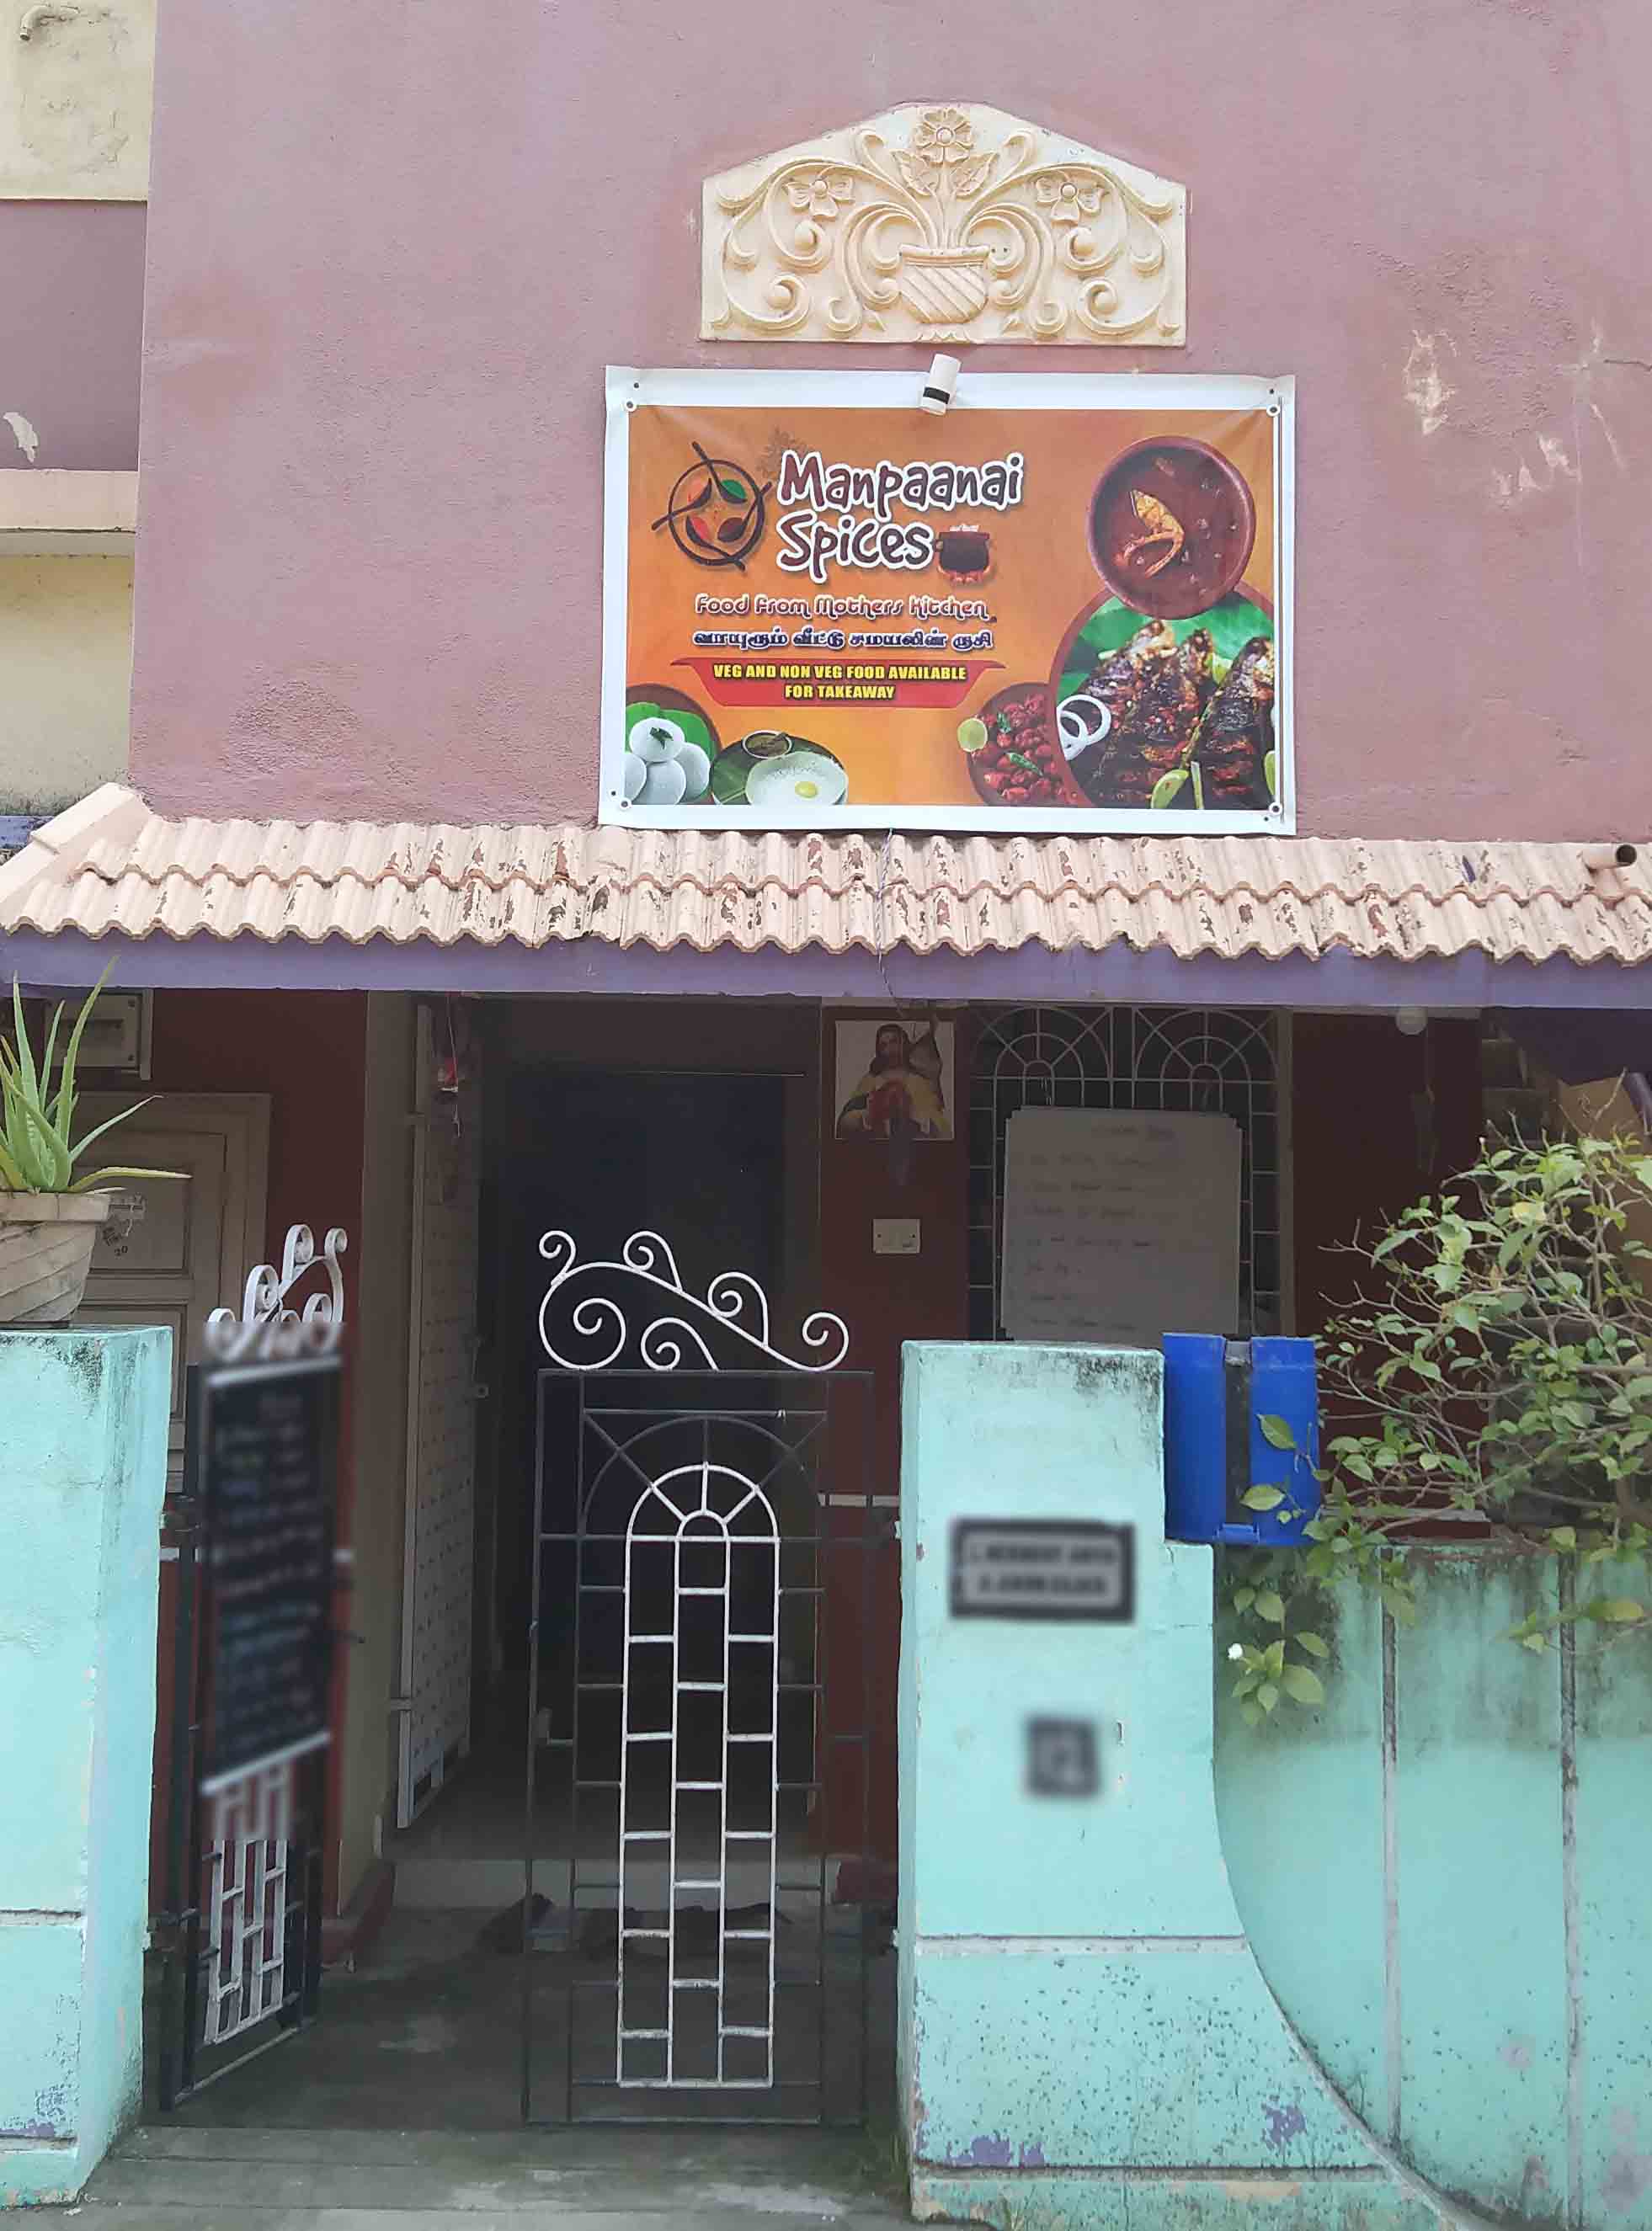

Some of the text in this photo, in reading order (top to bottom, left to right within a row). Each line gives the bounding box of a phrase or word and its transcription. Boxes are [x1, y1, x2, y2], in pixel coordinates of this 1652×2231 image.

[779, 452, 1022, 519] Manpaanai
[777, 510, 934, 581] Spices
[695, 594, 989, 621] Food From Mothers Kitchen
[713, 664, 967, 680] VEG AND NON VEG FOOD AVAILABLE
[785, 684, 895, 700] FOR TAKEAWAY
